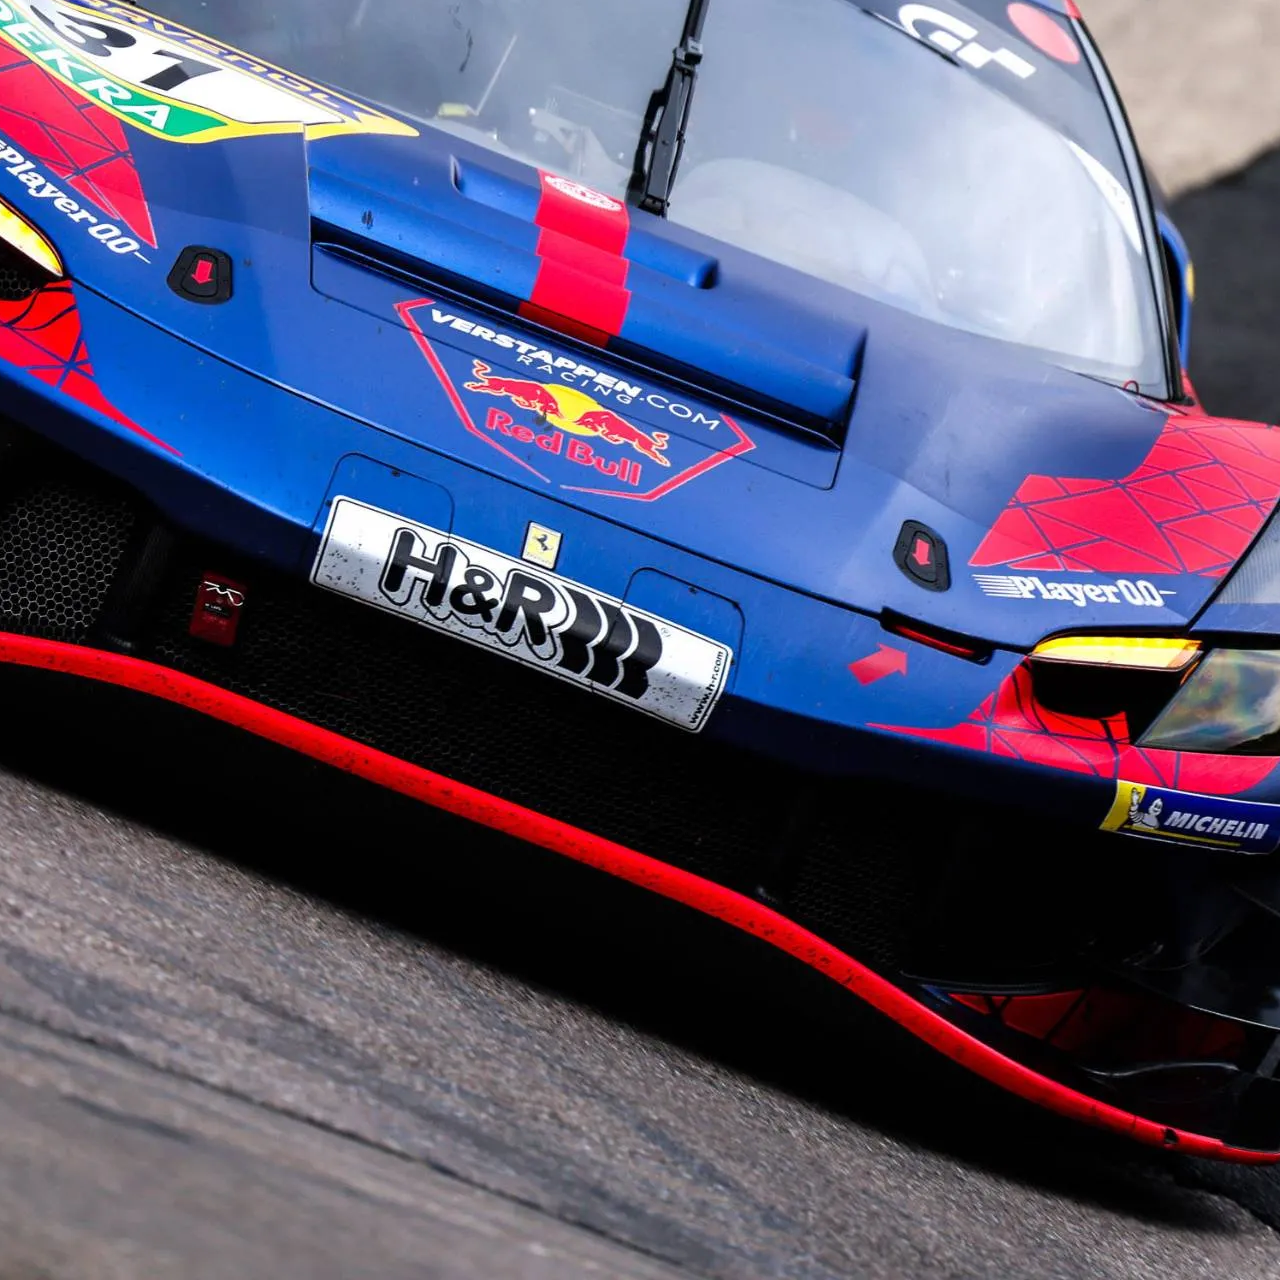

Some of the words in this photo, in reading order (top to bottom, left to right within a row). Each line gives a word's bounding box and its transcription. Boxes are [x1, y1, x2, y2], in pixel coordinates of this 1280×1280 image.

[29, 3, 223, 92] 31
[431, 308, 721, 431] VERSTAPPEN.COM
[516, 354, 633, 405] RACING
[485, 407, 564, 455] Red
[565, 439, 642, 486] Bull
[689, 650, 724, 724] www.h-r.com
[1164, 811, 1269, 840] MICHELIN
